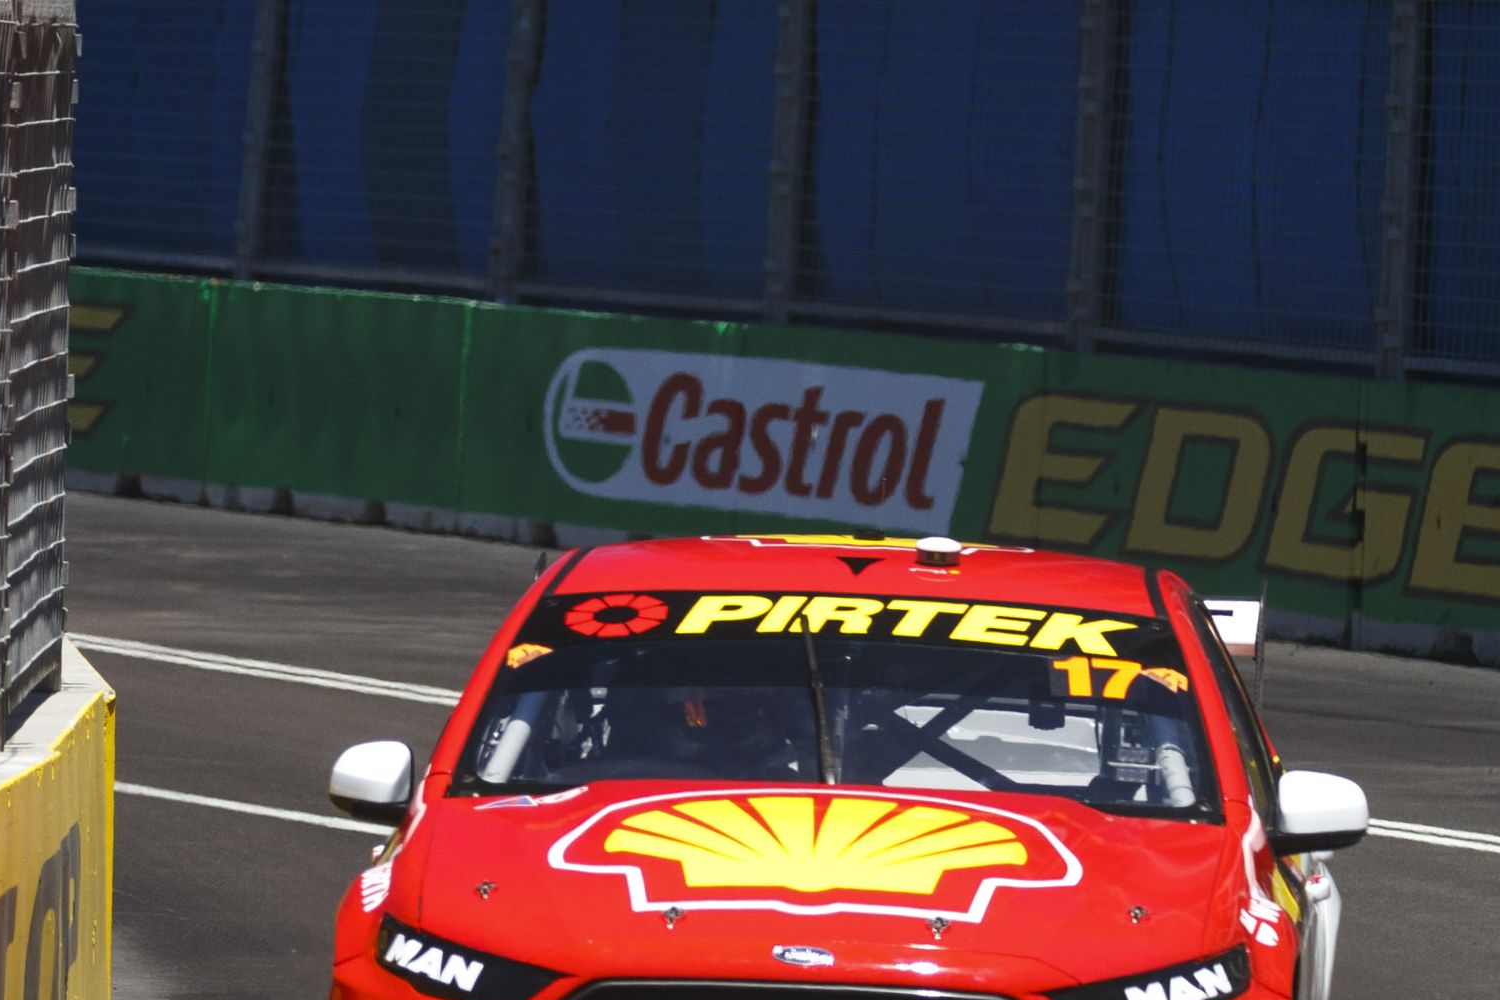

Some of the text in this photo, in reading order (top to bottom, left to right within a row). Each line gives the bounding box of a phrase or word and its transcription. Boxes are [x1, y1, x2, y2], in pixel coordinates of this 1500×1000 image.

[641, 371, 945, 509] Castrol
[986, 391, 1500, 600] EDGE
[675, 595, 1140, 658] PIRTEK
[1053, 656, 1142, 699] 17
[384, 933, 485, 992] MAN
